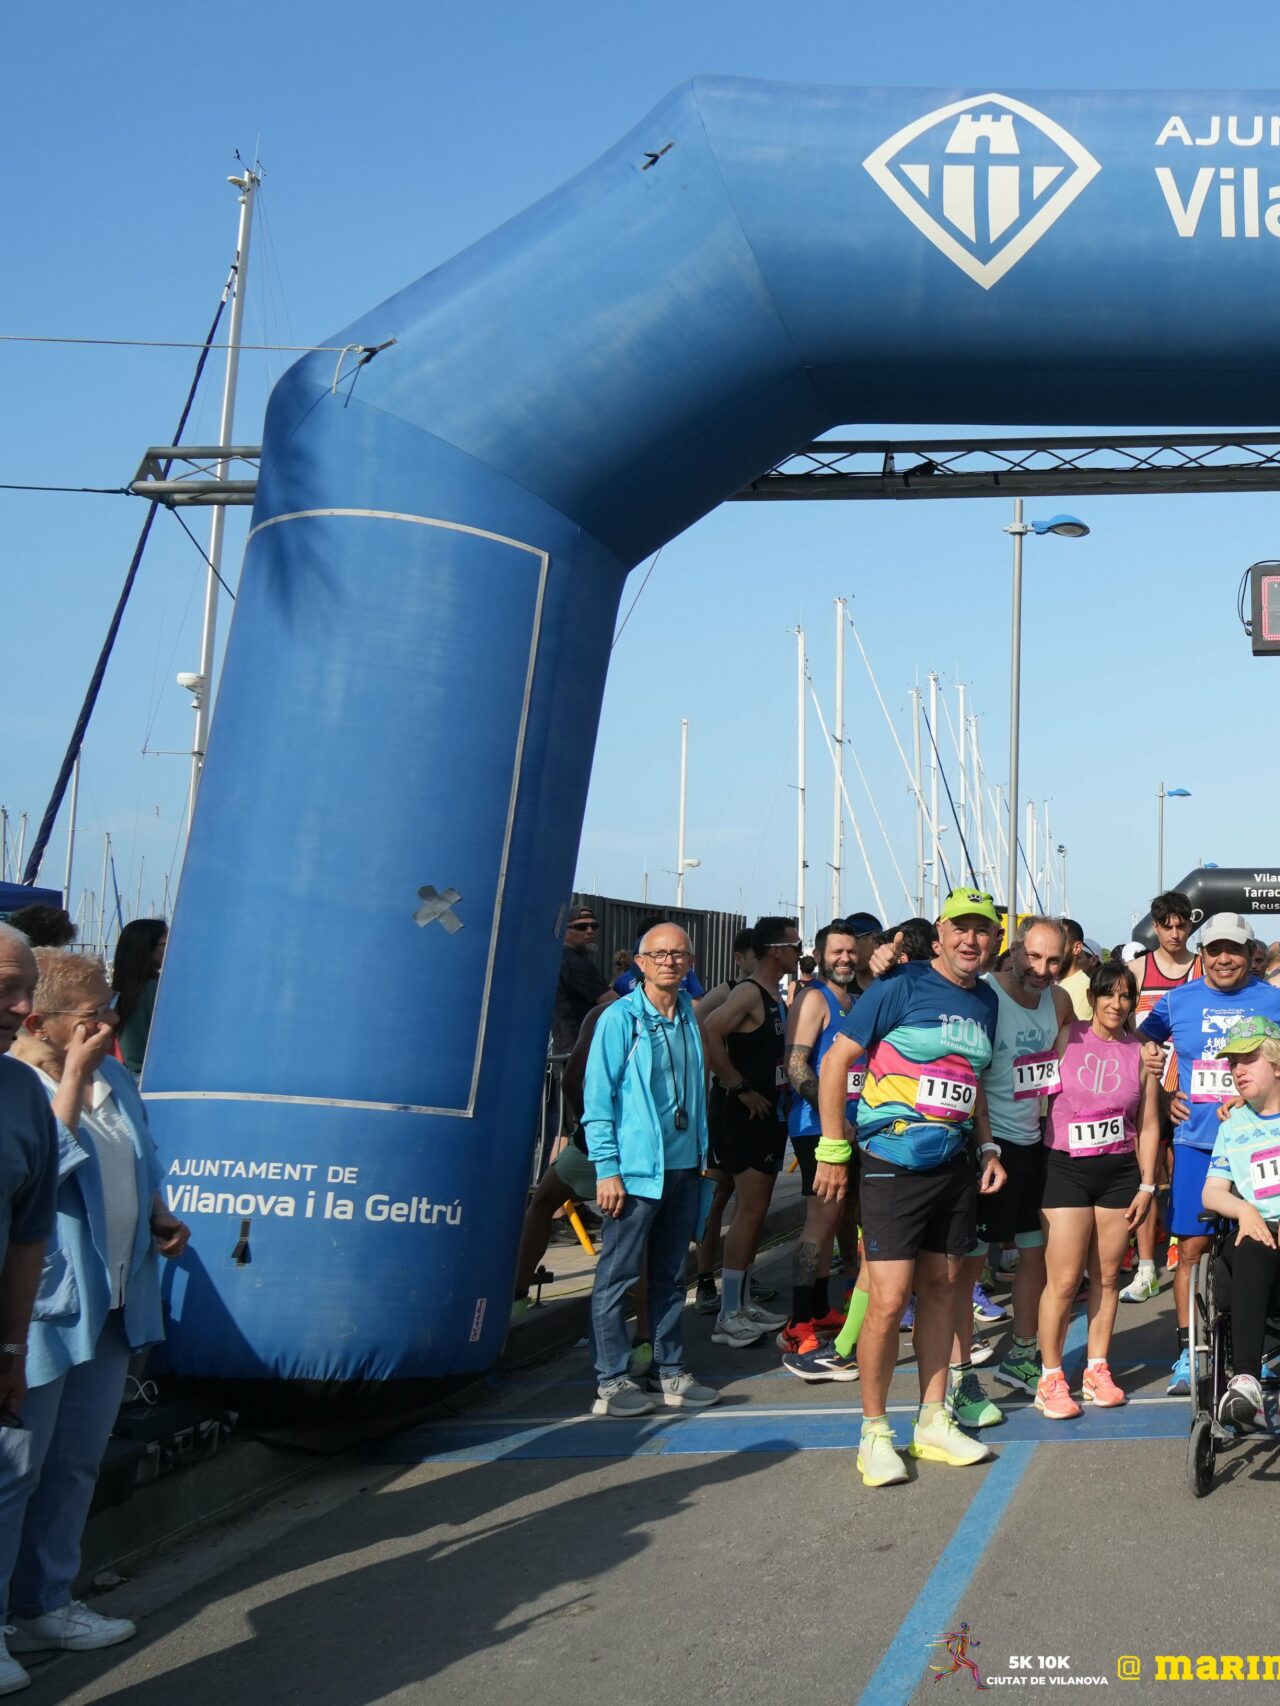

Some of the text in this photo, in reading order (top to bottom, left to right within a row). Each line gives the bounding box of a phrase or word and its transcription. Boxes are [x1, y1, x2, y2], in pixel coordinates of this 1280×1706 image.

[1017, 1062, 1054, 1084] 1178
[927, 1078, 972, 1104] 1150
[1075, 1119, 1120, 1141] 1176
[168, 1158, 359, 1185] AJUNTAMENT DE
[166, 1184, 463, 1226] Vilanova i la Geltrú
